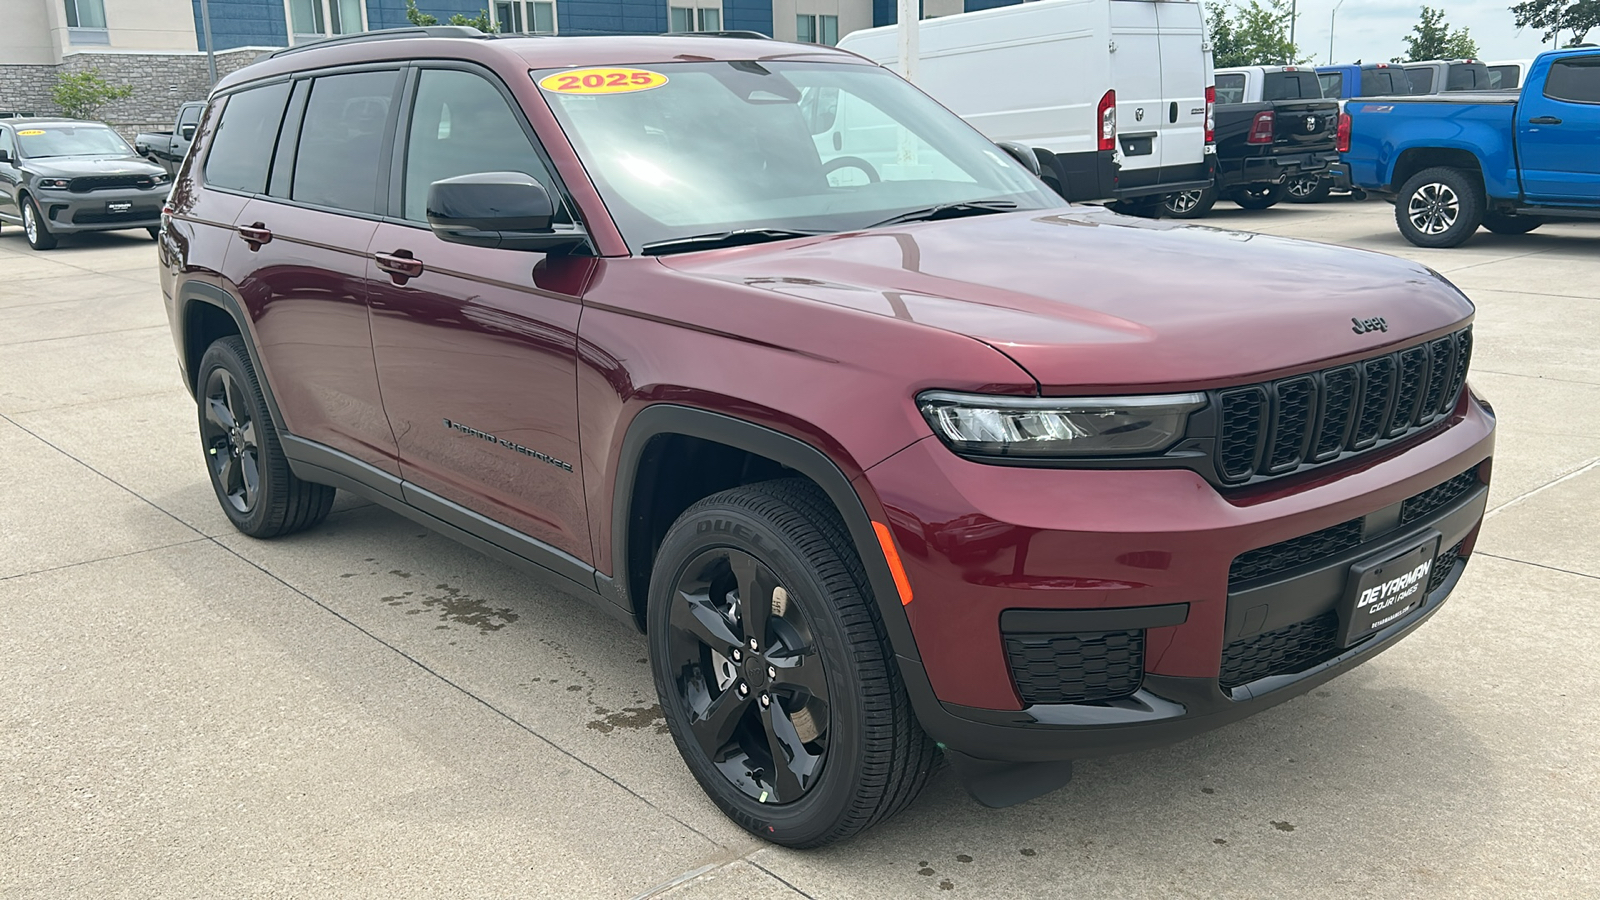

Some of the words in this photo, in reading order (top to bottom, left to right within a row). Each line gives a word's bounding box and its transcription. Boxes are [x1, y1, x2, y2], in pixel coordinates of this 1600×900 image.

[557, 72, 653, 91] 2025
[1351, 317, 1388, 335] Jeep
[452, 422, 497, 443] GRAND
[499, 438, 573, 473] CHEROKEE
[1357, 558, 1432, 608] DEYARMAN
